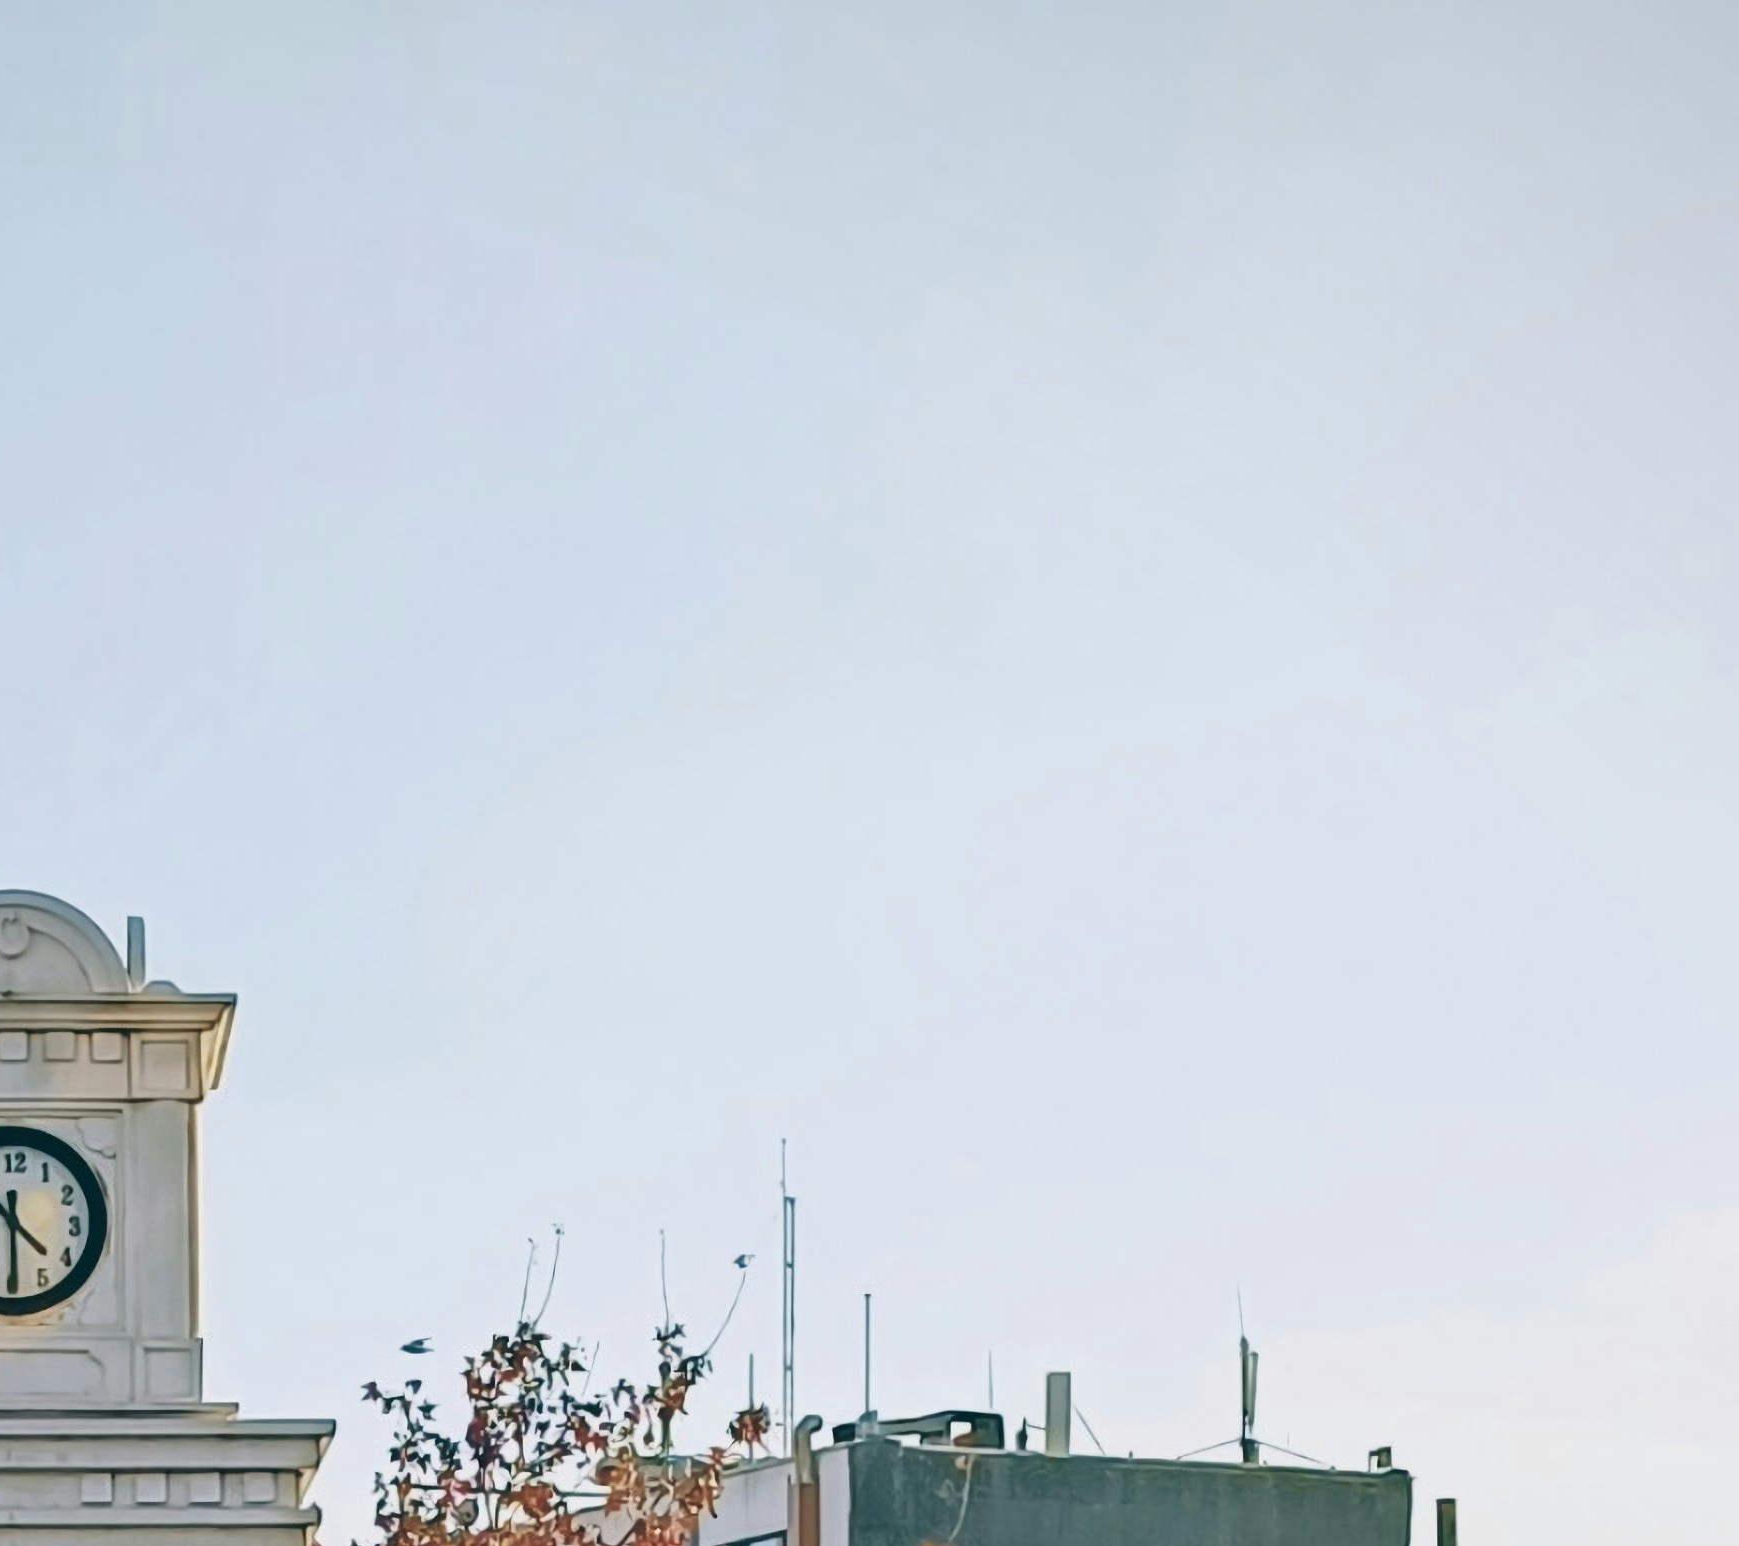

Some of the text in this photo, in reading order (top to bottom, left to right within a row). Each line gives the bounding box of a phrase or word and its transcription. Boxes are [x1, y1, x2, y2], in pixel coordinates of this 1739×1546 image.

[5, 1152, 27, 1173] 12
[41, 1162, 49, 1183] 1
[60, 1184, 74, 1206] 2
[68, 1216, 81, 1237] 3
[60, 1247, 72, 1267] 4
[37, 1268, 49, 1287] 5
